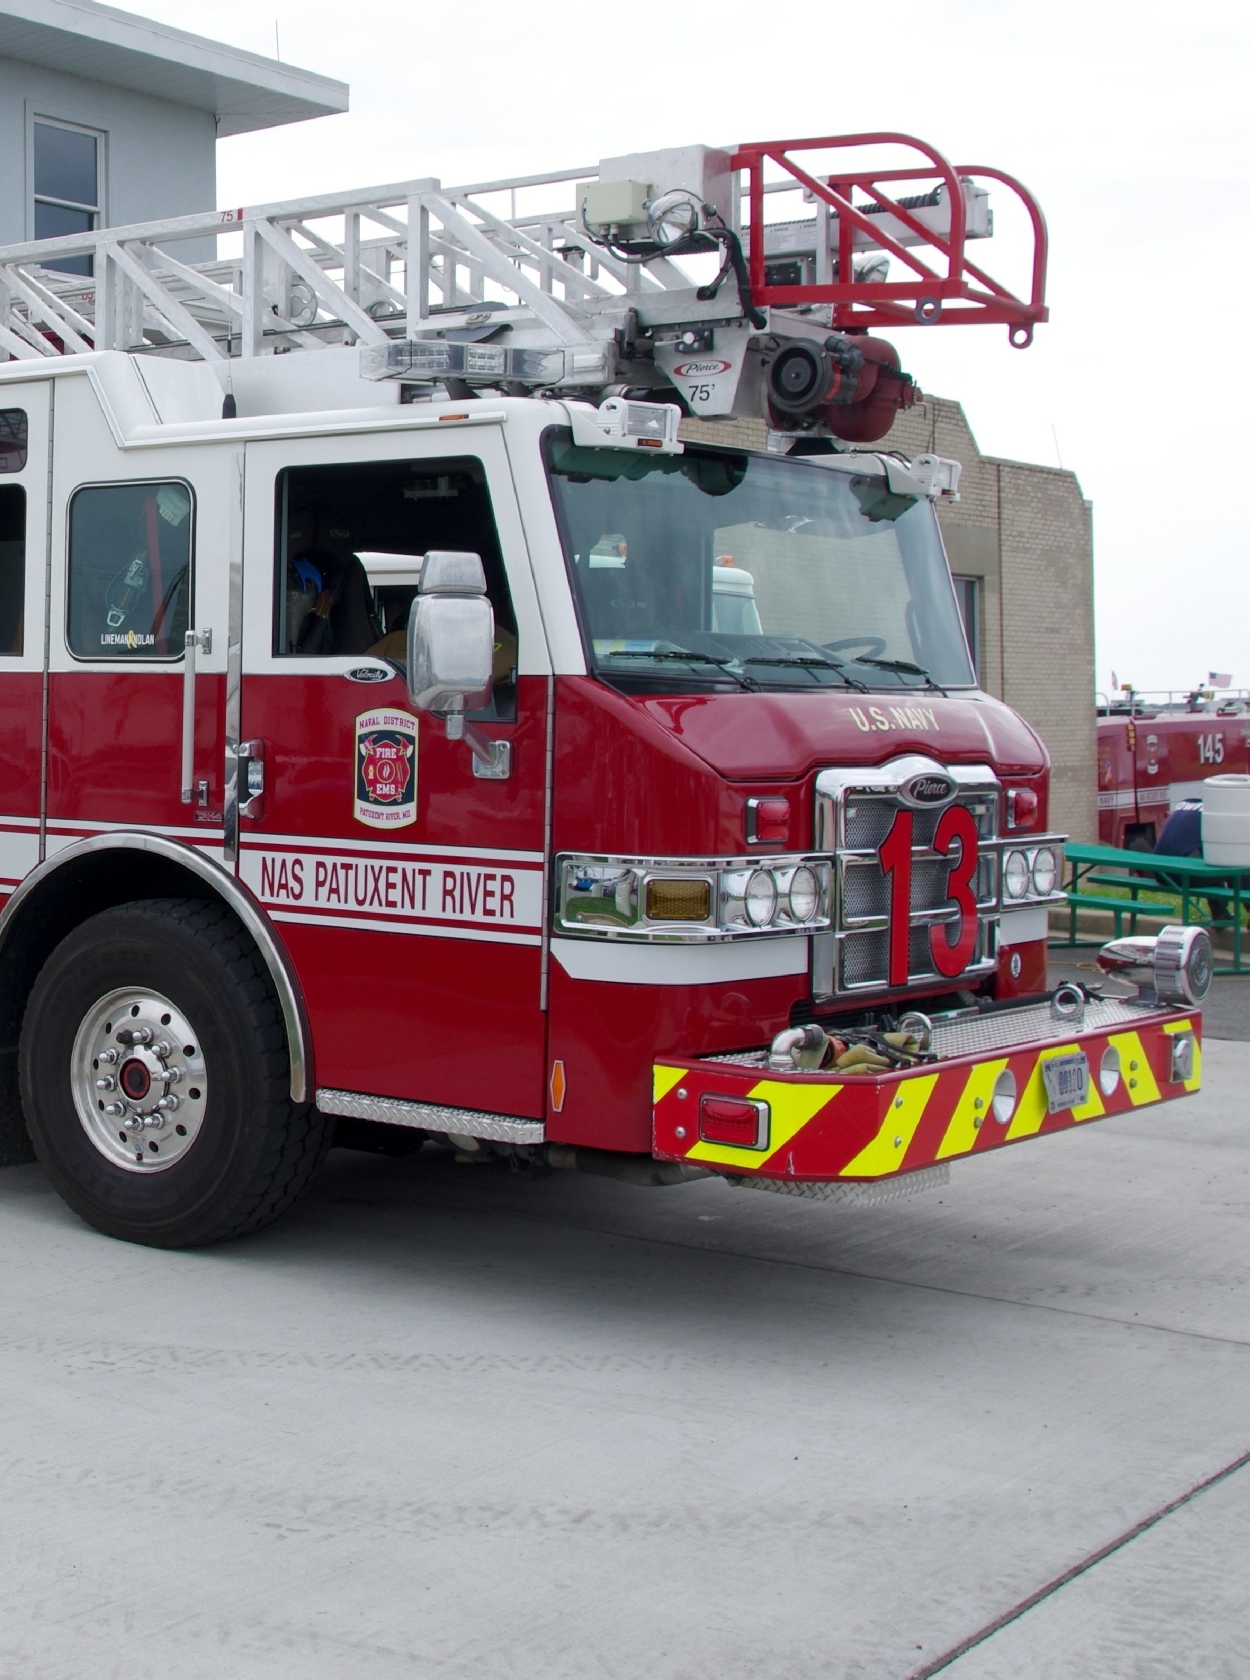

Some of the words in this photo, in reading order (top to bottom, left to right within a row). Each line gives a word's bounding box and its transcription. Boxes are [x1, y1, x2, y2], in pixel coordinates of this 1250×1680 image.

[220, 210, 234, 223] 75
[685, 363, 720, 374] Pierce
[133, 633, 155, 645] NOLAN
[356, 669, 384, 680] Velocity
[359, 716, 381, 729] NAVAL
[383, 715, 416, 730] DISTRICT
[848, 706, 896, 732] U.S.
[888, 706, 941, 731] NAVY
[376, 747, 397, 758] FIRE
[1197, 733, 1224, 764] 145
[376, 783, 396, 795] EMS
[913, 779, 948, 798] Pierce
[261, 856, 304, 900] NAS
[314, 860, 432, 911] PATUXENT
[441, 870, 516, 918] RIVER
[877, 804, 980, 987] 13
